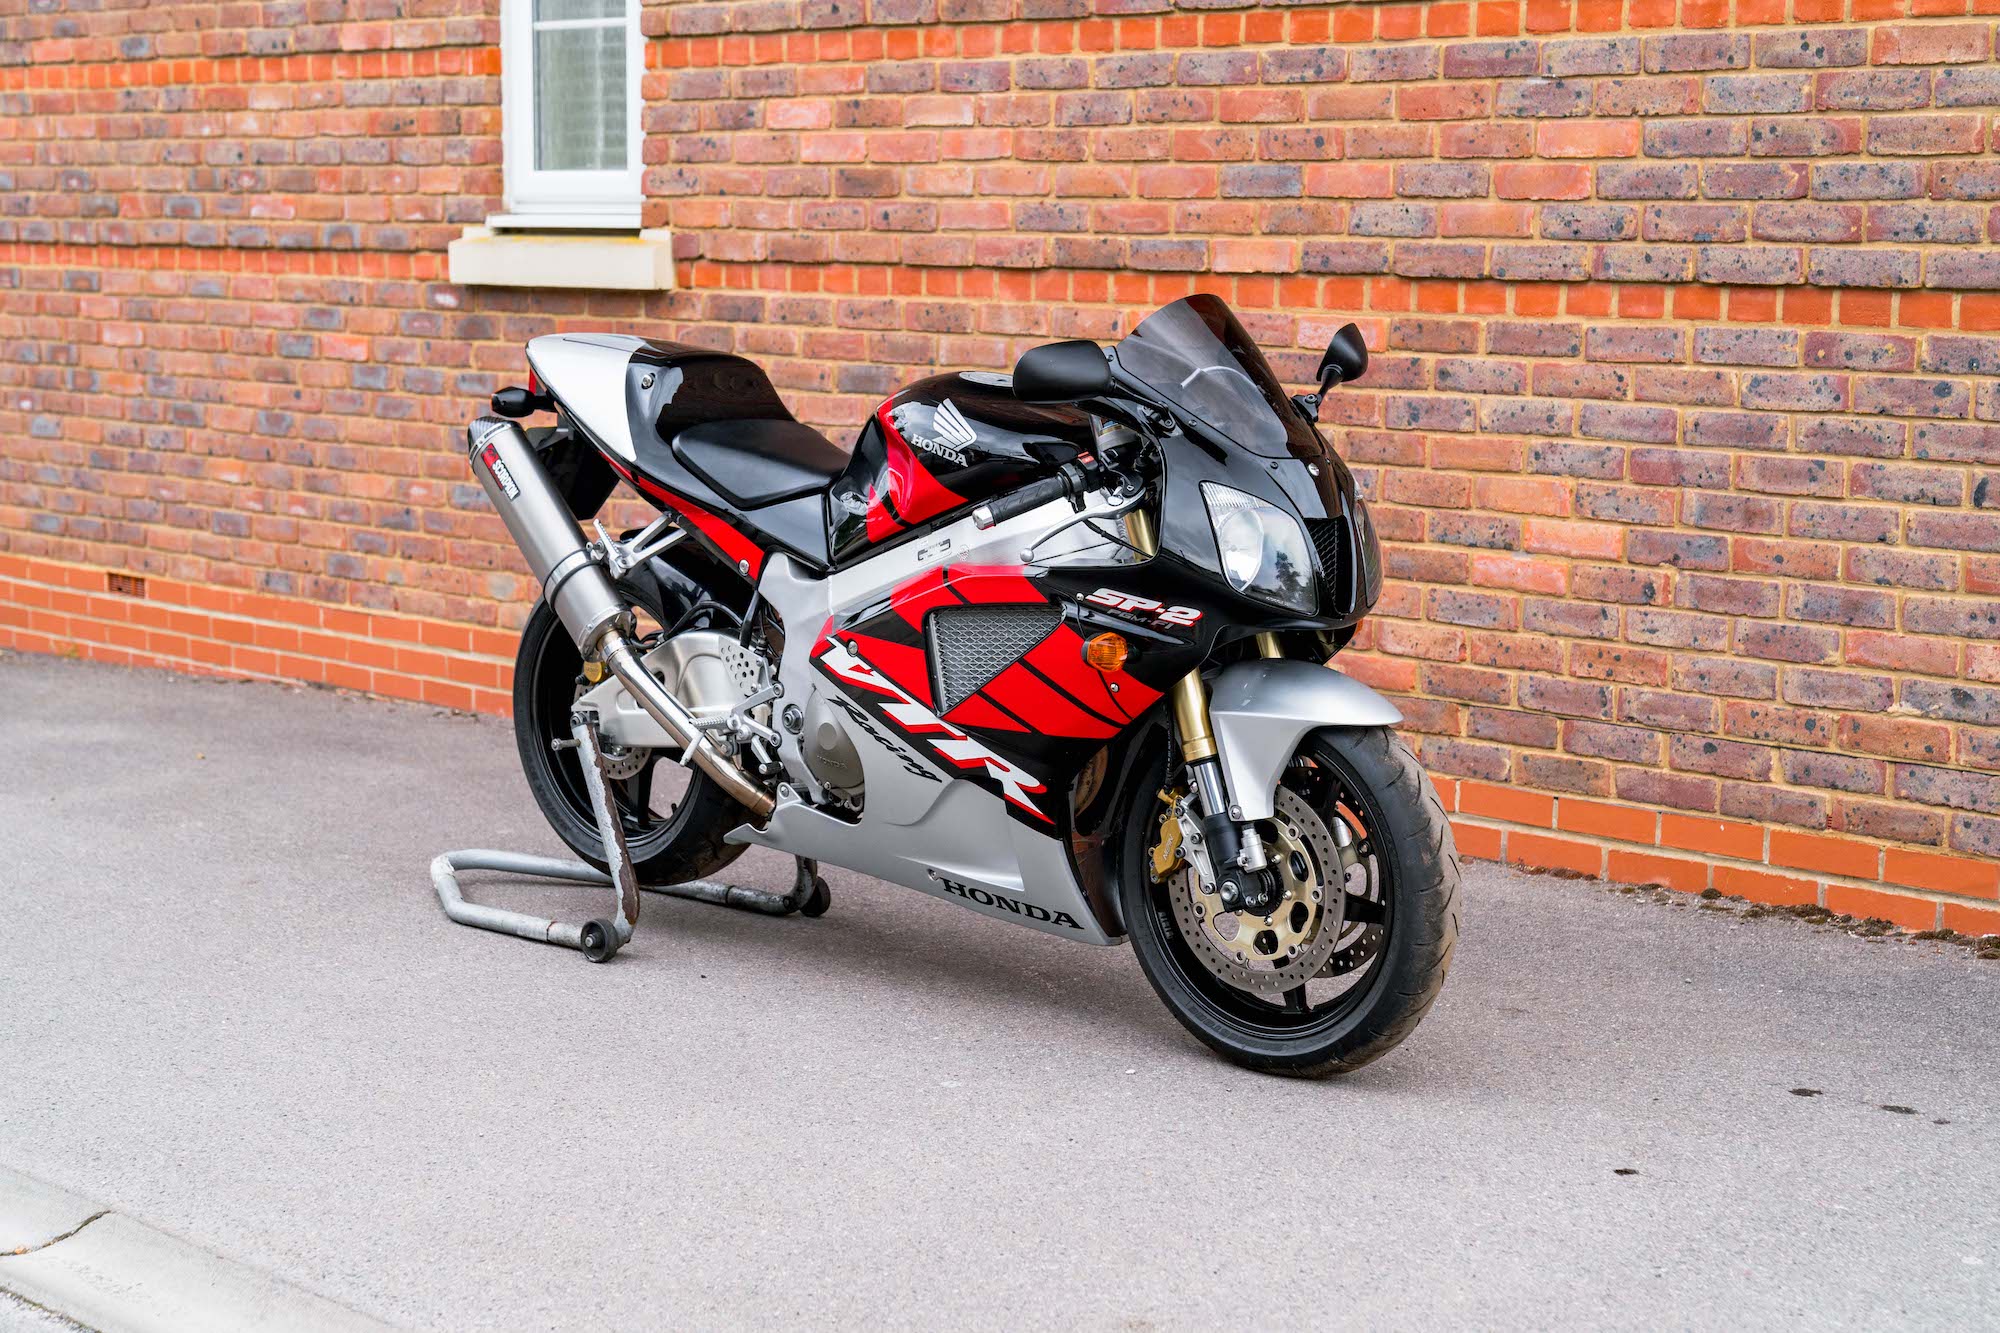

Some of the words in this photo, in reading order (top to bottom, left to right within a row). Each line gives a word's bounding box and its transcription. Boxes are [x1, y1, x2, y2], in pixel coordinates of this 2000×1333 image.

[911, 434, 968, 467] HONDA
[492, 459, 519, 500] SCORPION
[1085, 588, 1203, 627] SP-2
[1107, 608, 1175, 630] PGM-FI
[820, 634, 1056, 825] VTR
[827, 695, 942, 783] Racing
[940, 876, 1085, 930] HONDA
